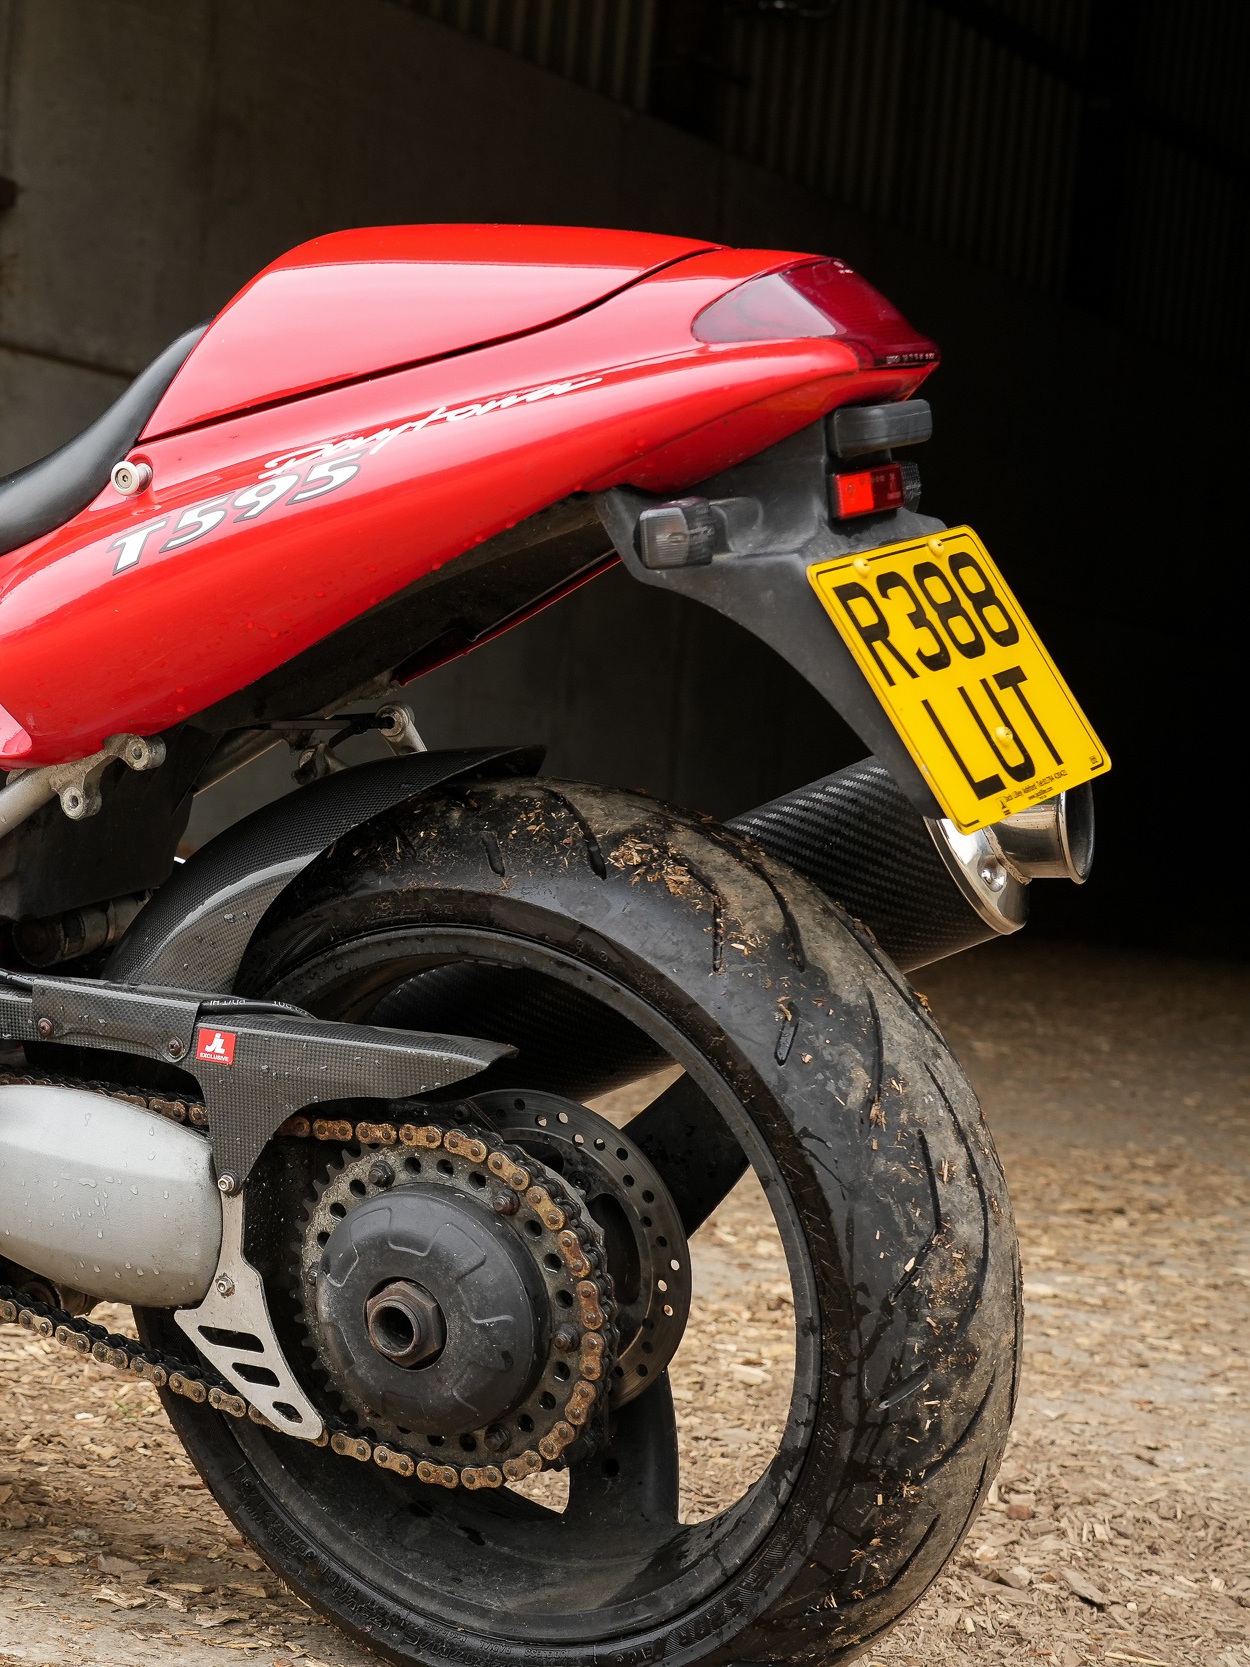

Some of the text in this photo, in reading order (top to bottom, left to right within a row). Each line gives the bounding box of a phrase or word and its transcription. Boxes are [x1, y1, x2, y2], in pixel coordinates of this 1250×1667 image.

[106, 448, 369, 575] T595
[832, 551, 1020, 688] R388
[921, 665, 1064, 801] LUT
[199, 1052, 230, 1062] EXCLUSIVE
